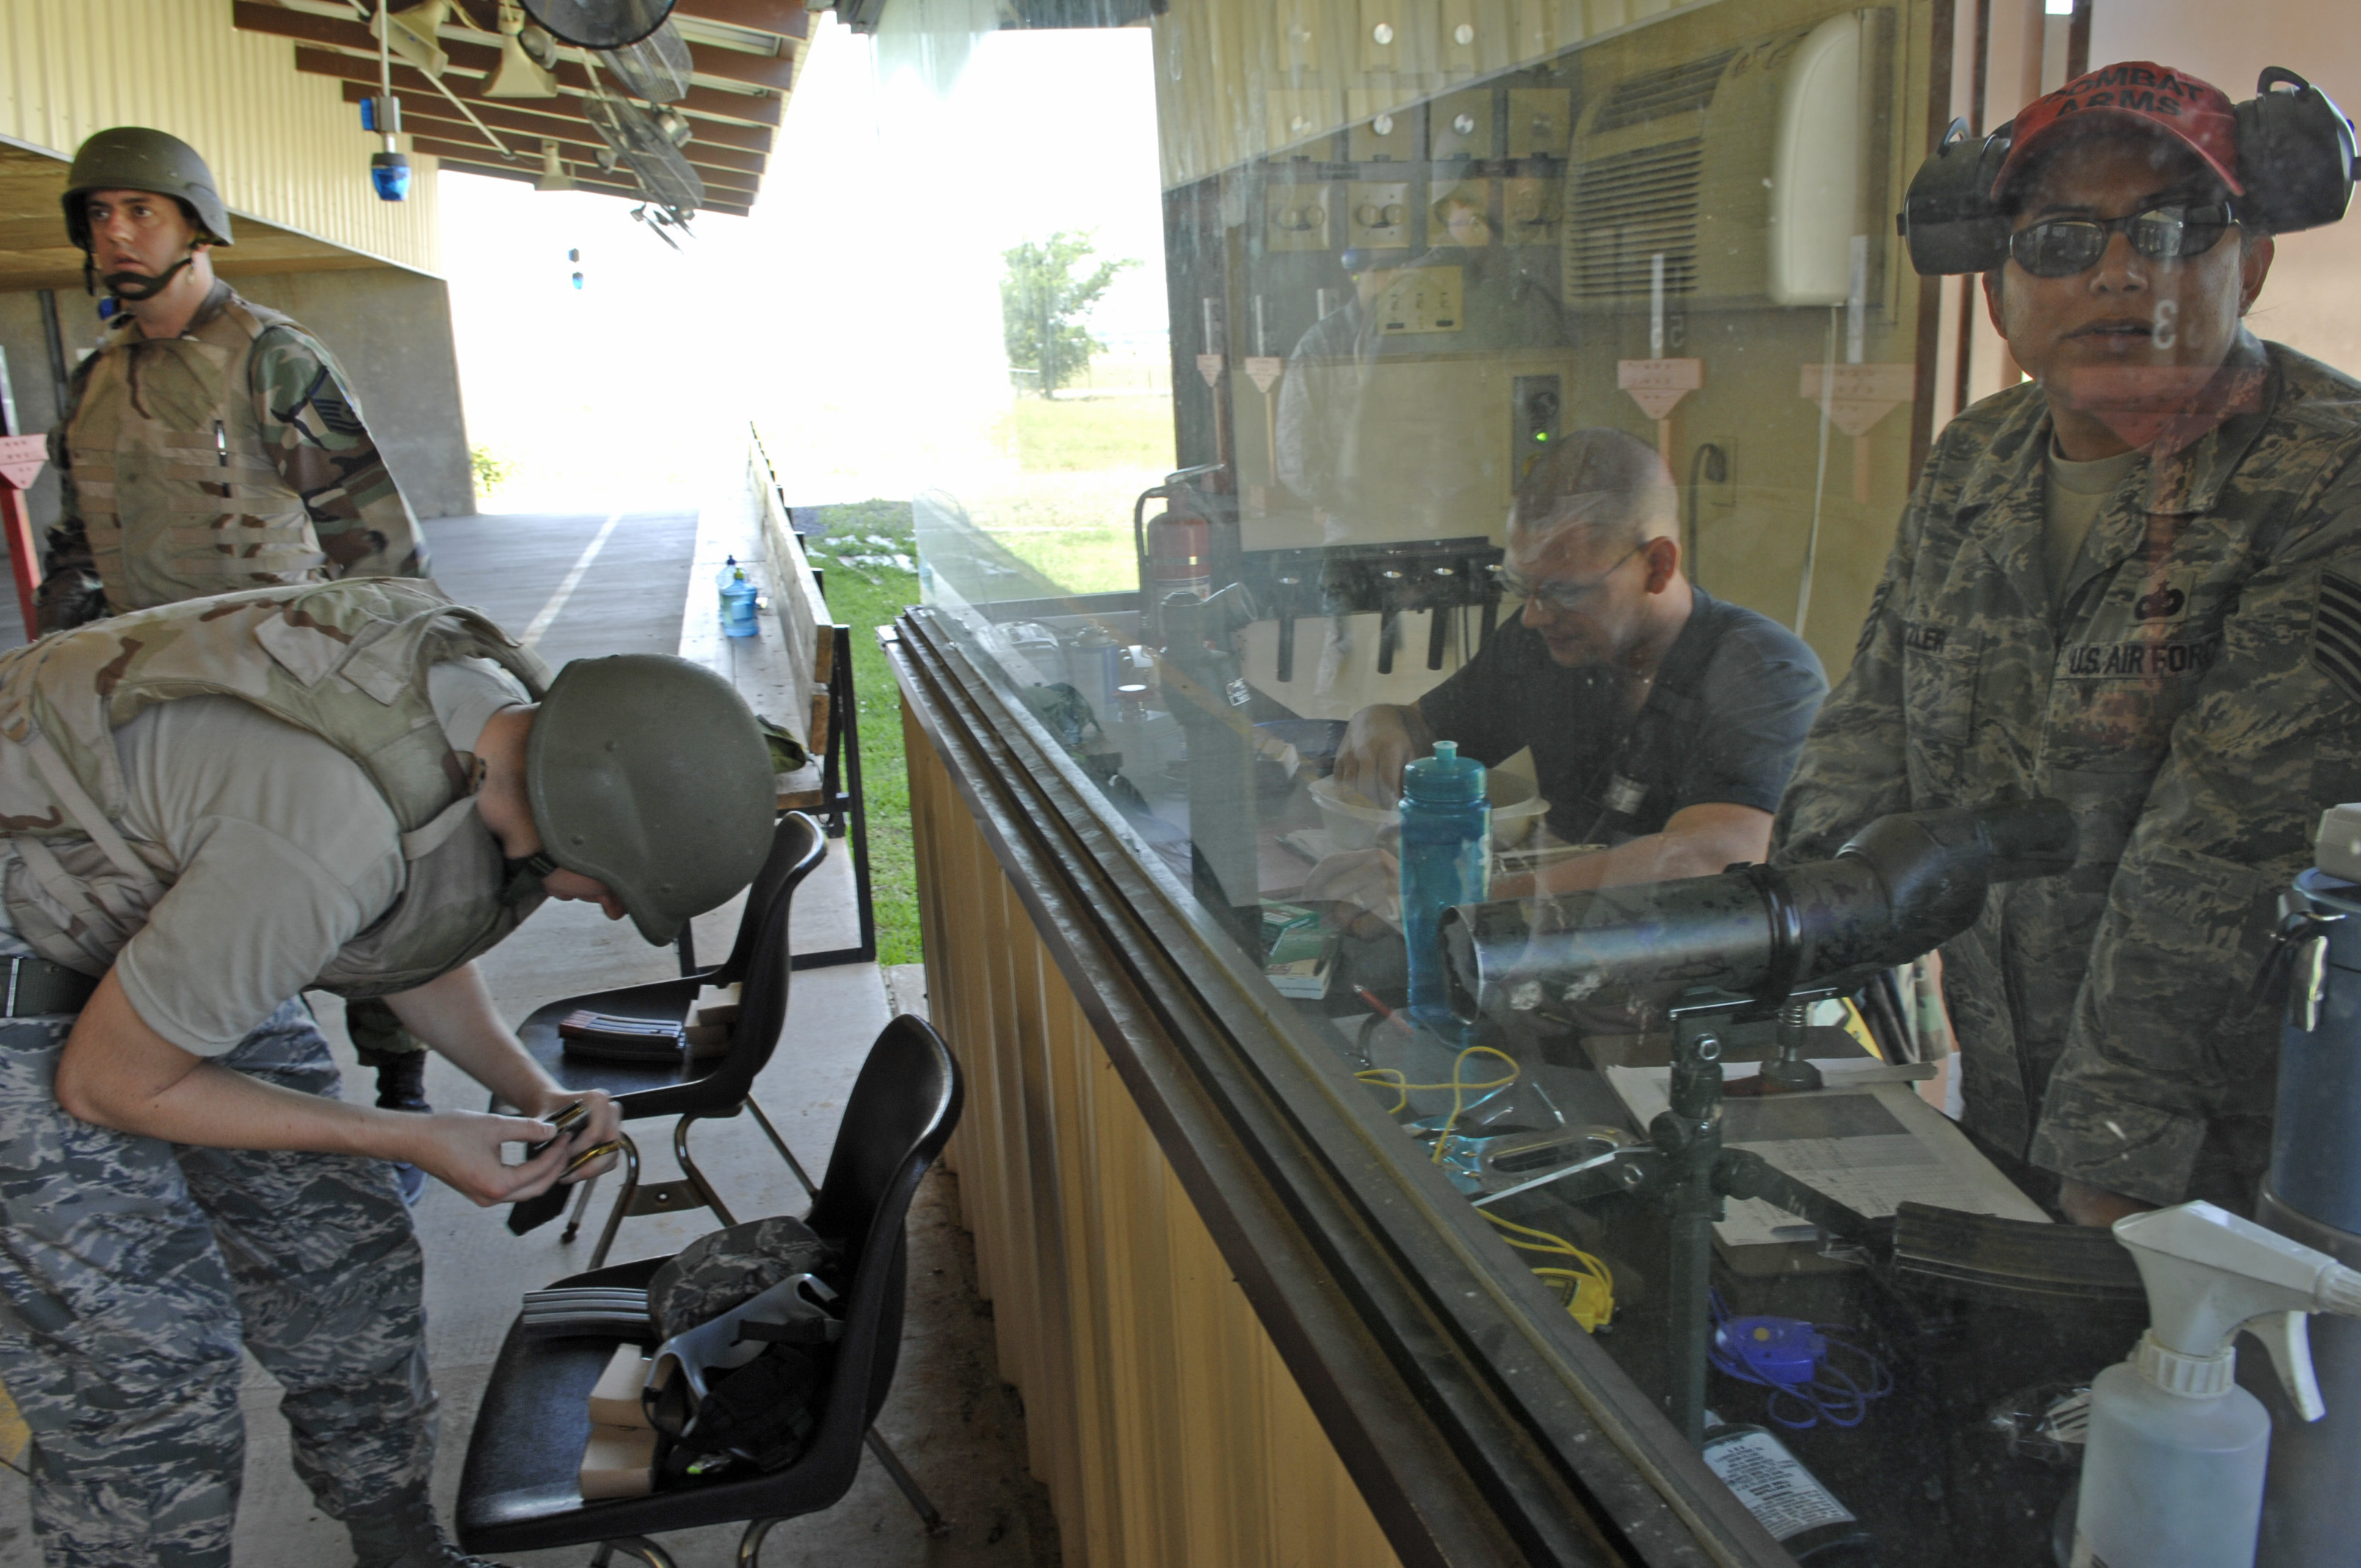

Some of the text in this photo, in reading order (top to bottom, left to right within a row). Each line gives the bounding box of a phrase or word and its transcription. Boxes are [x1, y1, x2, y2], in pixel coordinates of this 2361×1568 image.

[2044, 67, 2204, 101] COMBAT
[2056, 89, 2183, 117] ARMS
[2070, 646, 2101, 674] U.S.
[2104, 644, 2143, 674] AIR
